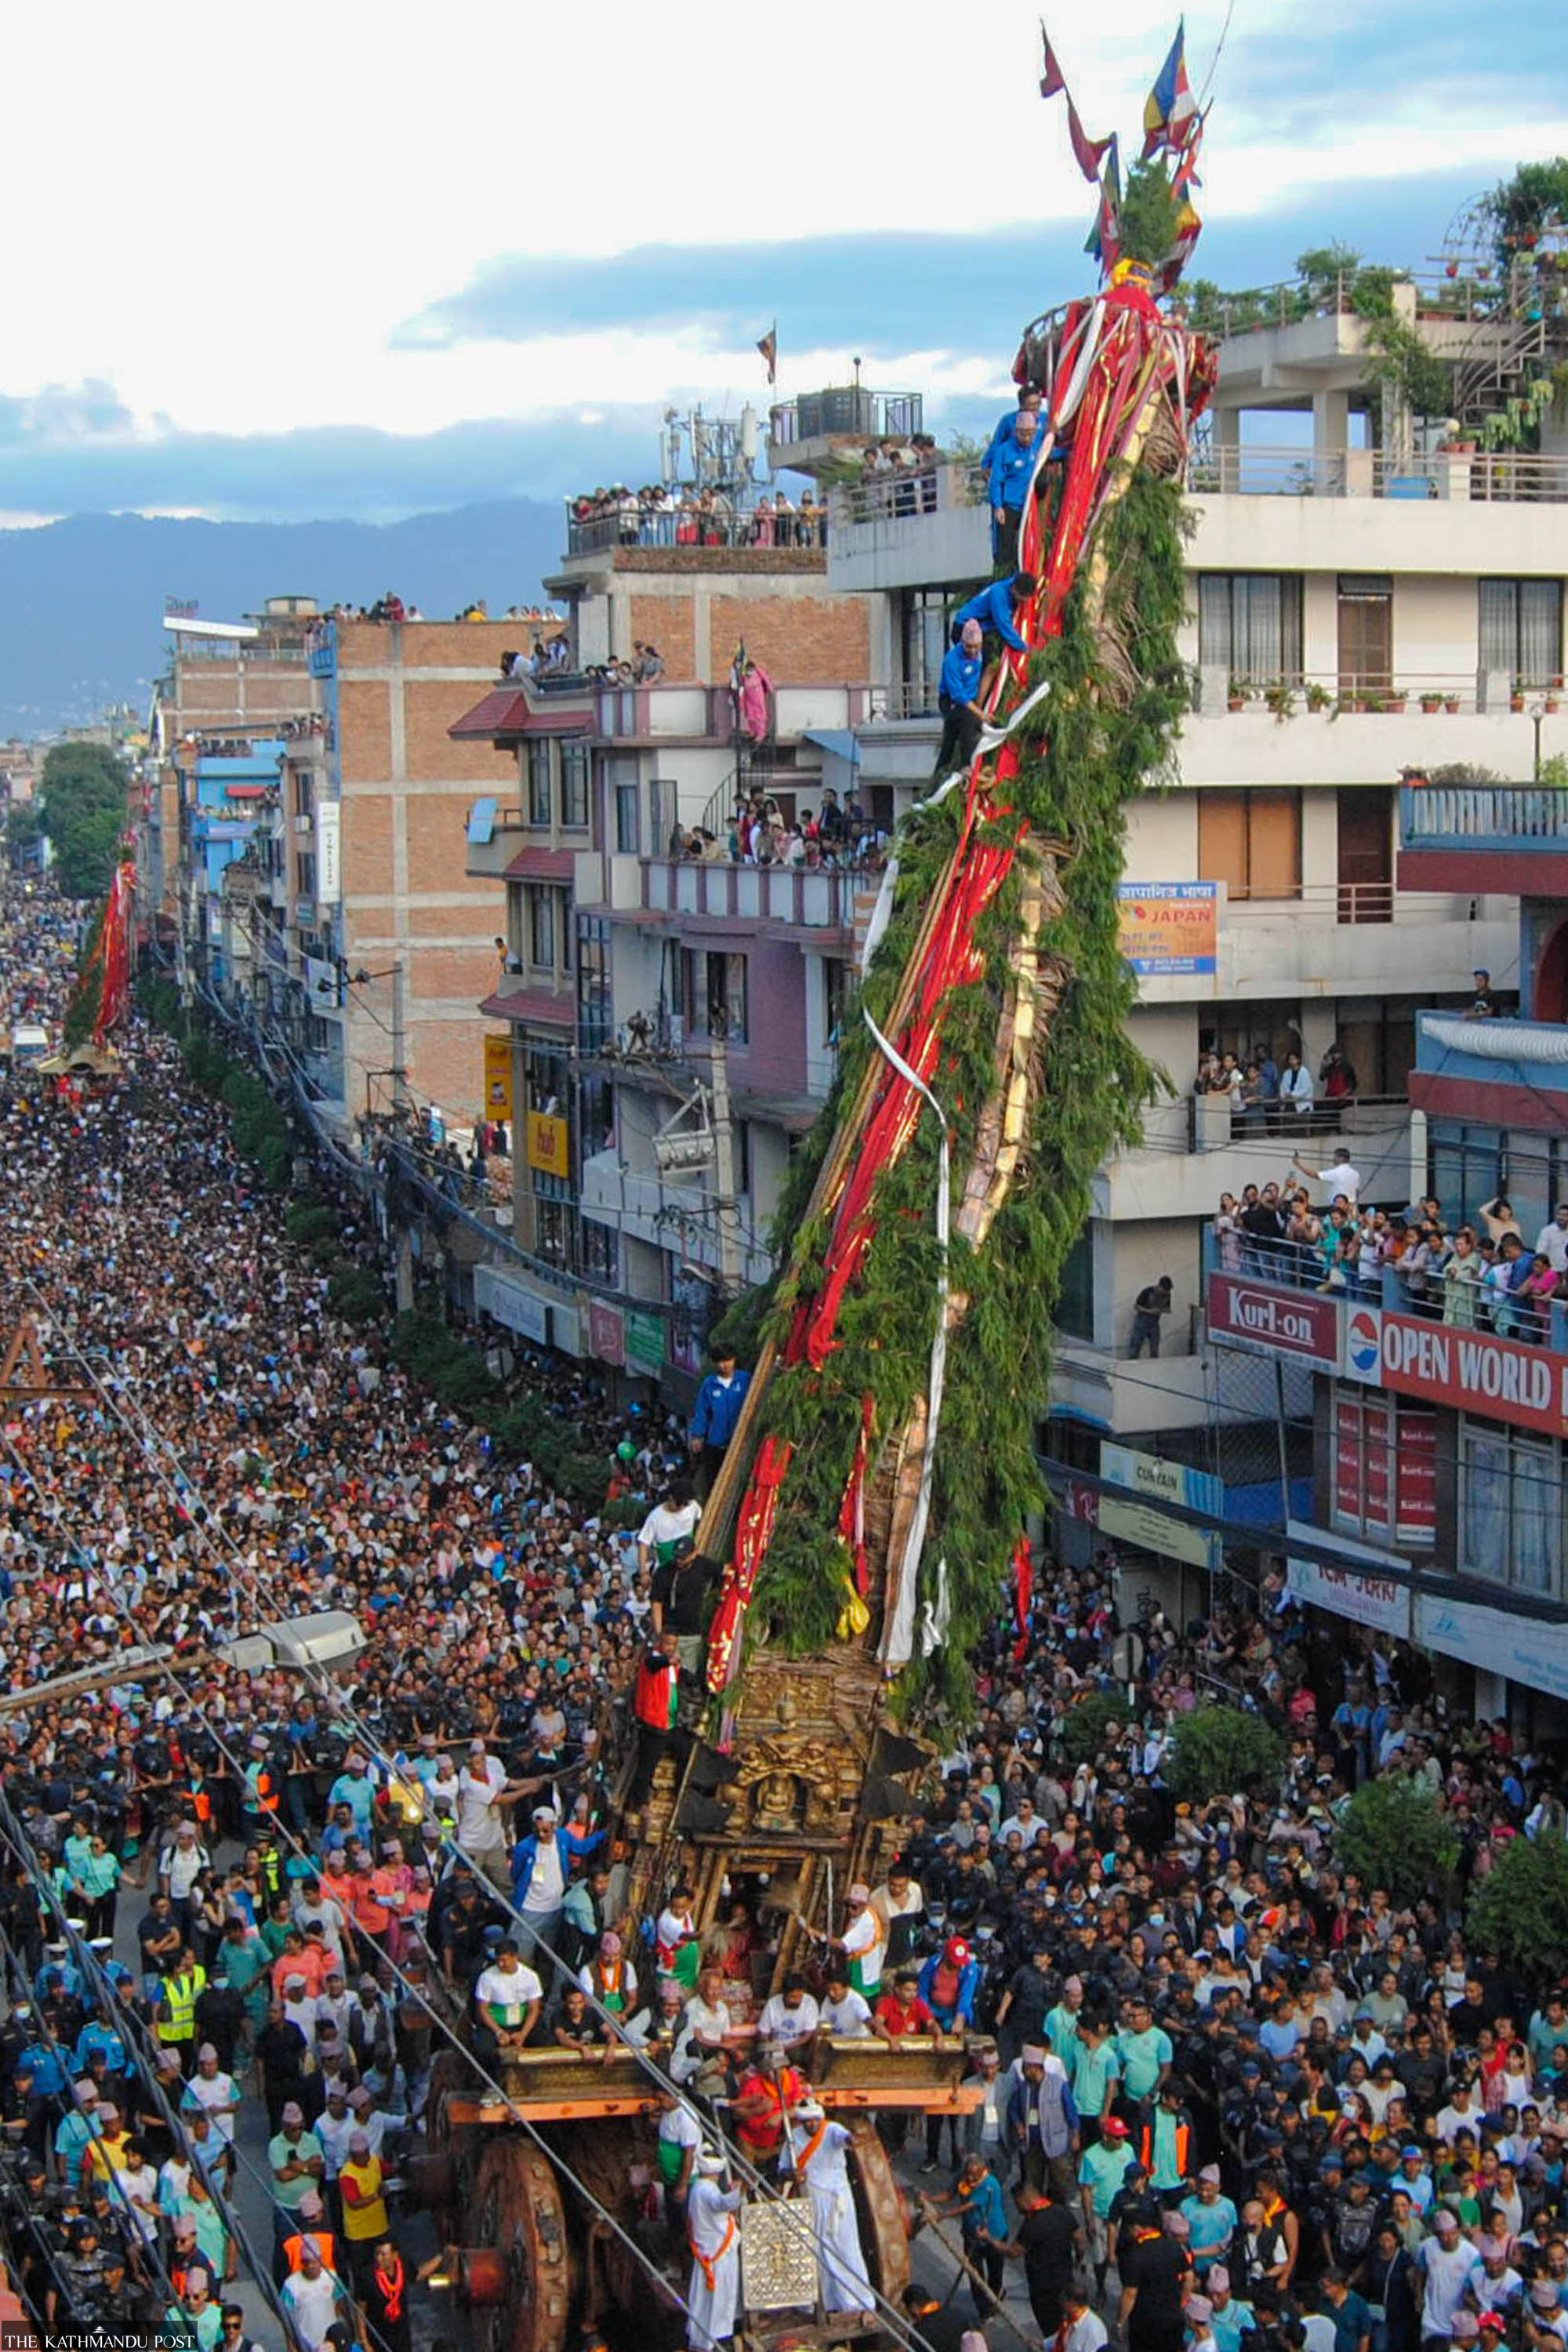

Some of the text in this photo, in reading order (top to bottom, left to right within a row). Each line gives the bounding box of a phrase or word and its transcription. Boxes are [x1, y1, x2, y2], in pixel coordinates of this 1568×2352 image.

[1151, 910, 1211, 924] JAPAN
[1228, 1287, 1316, 1346] Kurl-on
[1383, 1323, 1449, 1385] OPEN
[1457, 1340, 1552, 1410] WORLD
